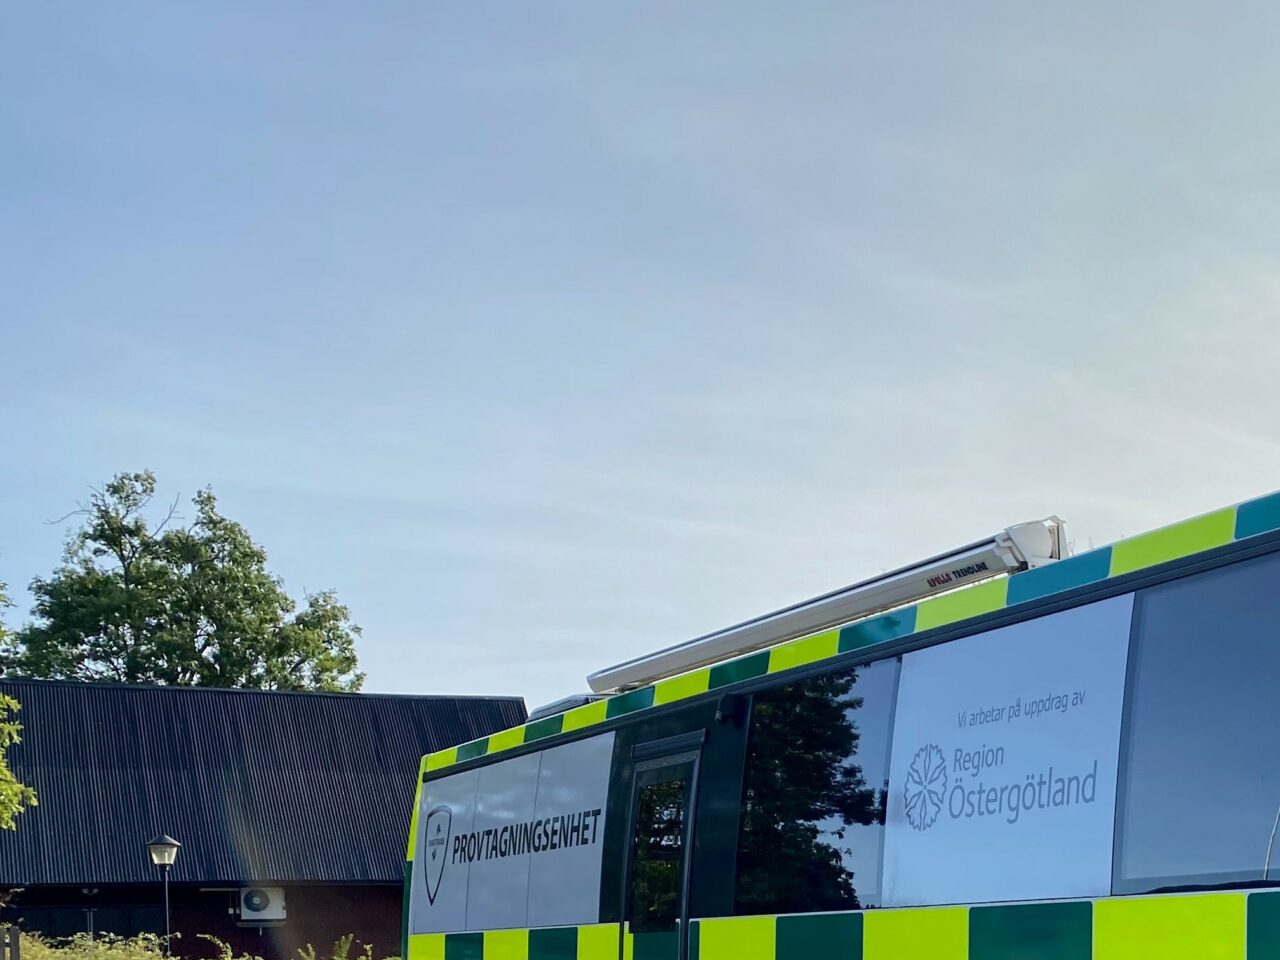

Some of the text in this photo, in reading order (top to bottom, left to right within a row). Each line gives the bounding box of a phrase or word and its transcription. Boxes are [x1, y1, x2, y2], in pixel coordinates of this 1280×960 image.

[952, 561, 989, 579] TRENDLINE
[957, 690, 1086, 728] Vi arbetar på uppdrag av
[953, 744, 1004, 777] Region
[949, 759, 1098, 825] Östergötland
[451, 808, 602, 865] PROVTAGNINGSENHET
